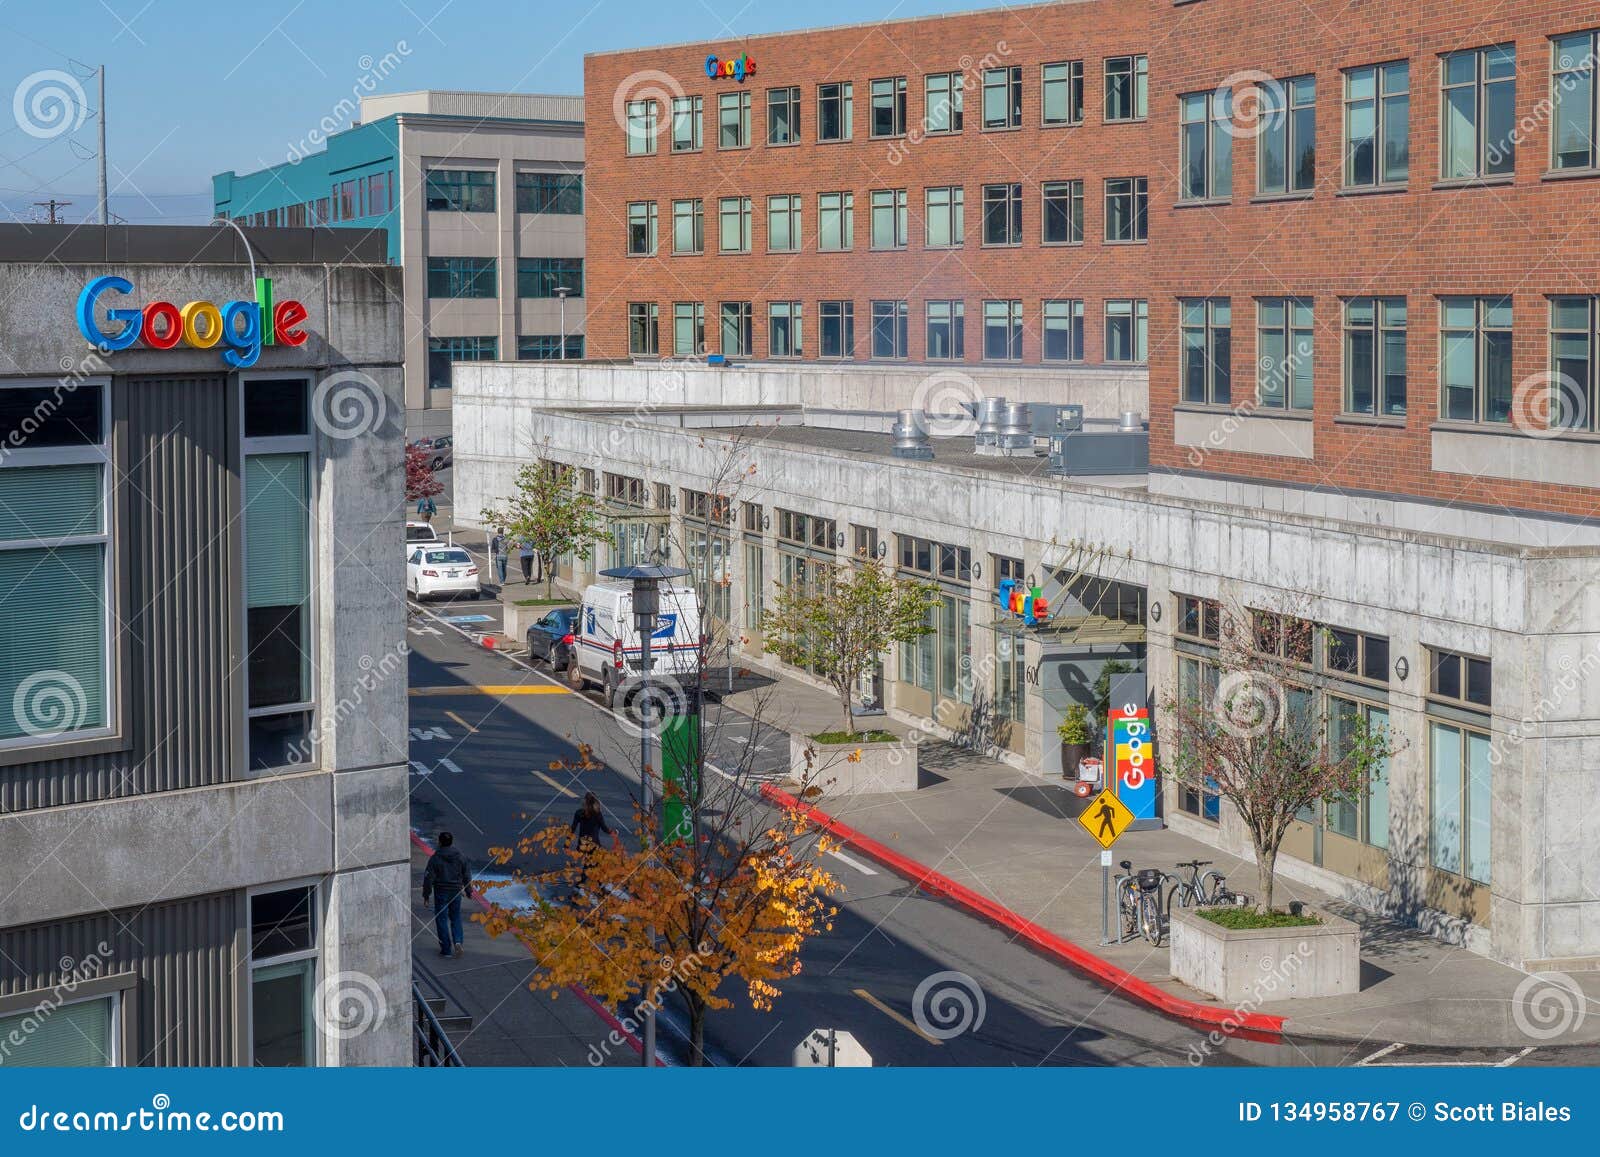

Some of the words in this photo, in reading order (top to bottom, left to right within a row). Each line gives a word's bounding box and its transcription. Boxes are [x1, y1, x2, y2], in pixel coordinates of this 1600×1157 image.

[704, 51, 756, 82] Google
[76, 275, 309, 368] Google
[1123, 703, 1146, 790] Google
